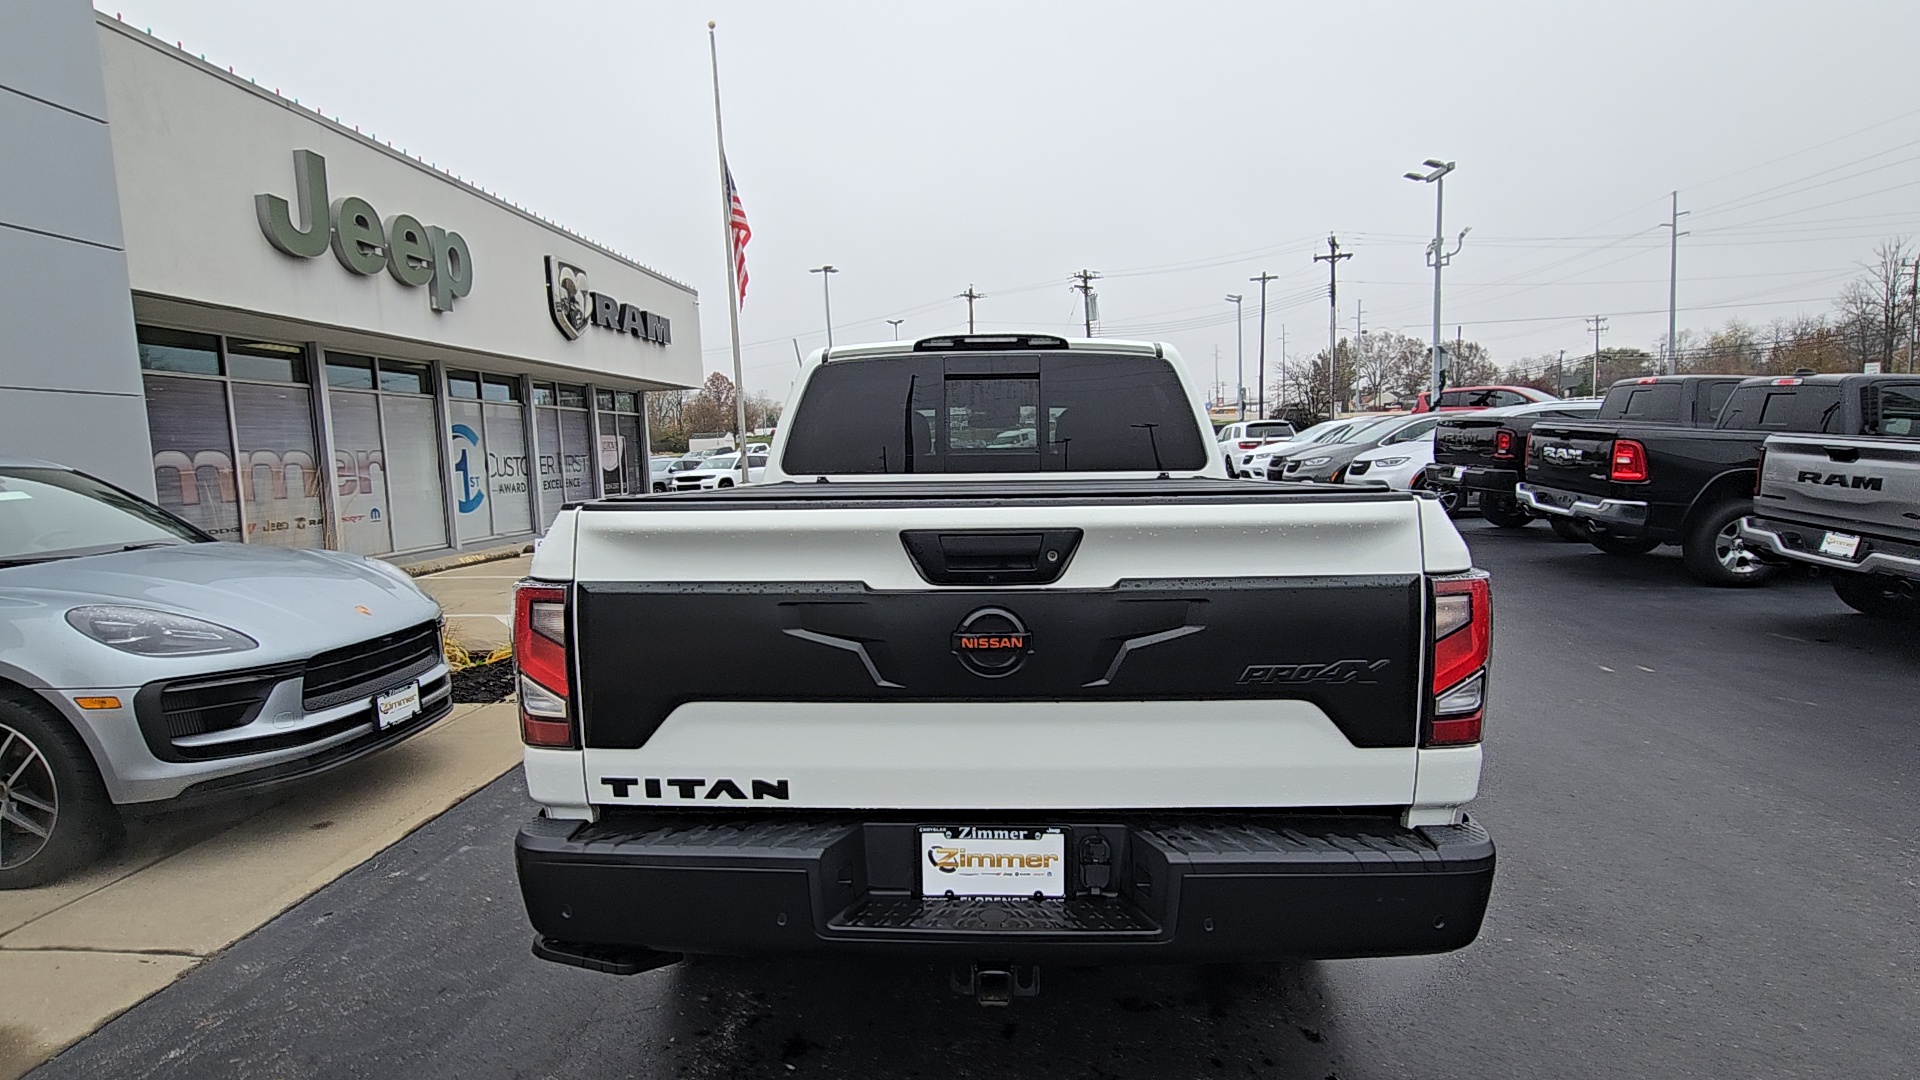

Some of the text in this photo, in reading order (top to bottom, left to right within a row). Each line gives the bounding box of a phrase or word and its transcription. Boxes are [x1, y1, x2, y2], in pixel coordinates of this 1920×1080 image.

[254, 149, 474, 313] Jeep
[590, 291, 672, 345] RAM
[1543, 446, 1583, 461] RAM
[489, 452, 556, 478] CUSTOER
[499, 478, 581, 494] AWARD EXCELENCE
[1797, 470, 1884, 491] RAM
[961, 637, 1023, 649] NISSAN
[600, 777, 789, 800] TITAN
[959, 826, 1029, 840] Zimmer
[936, 847, 1059, 868] Zimmer
